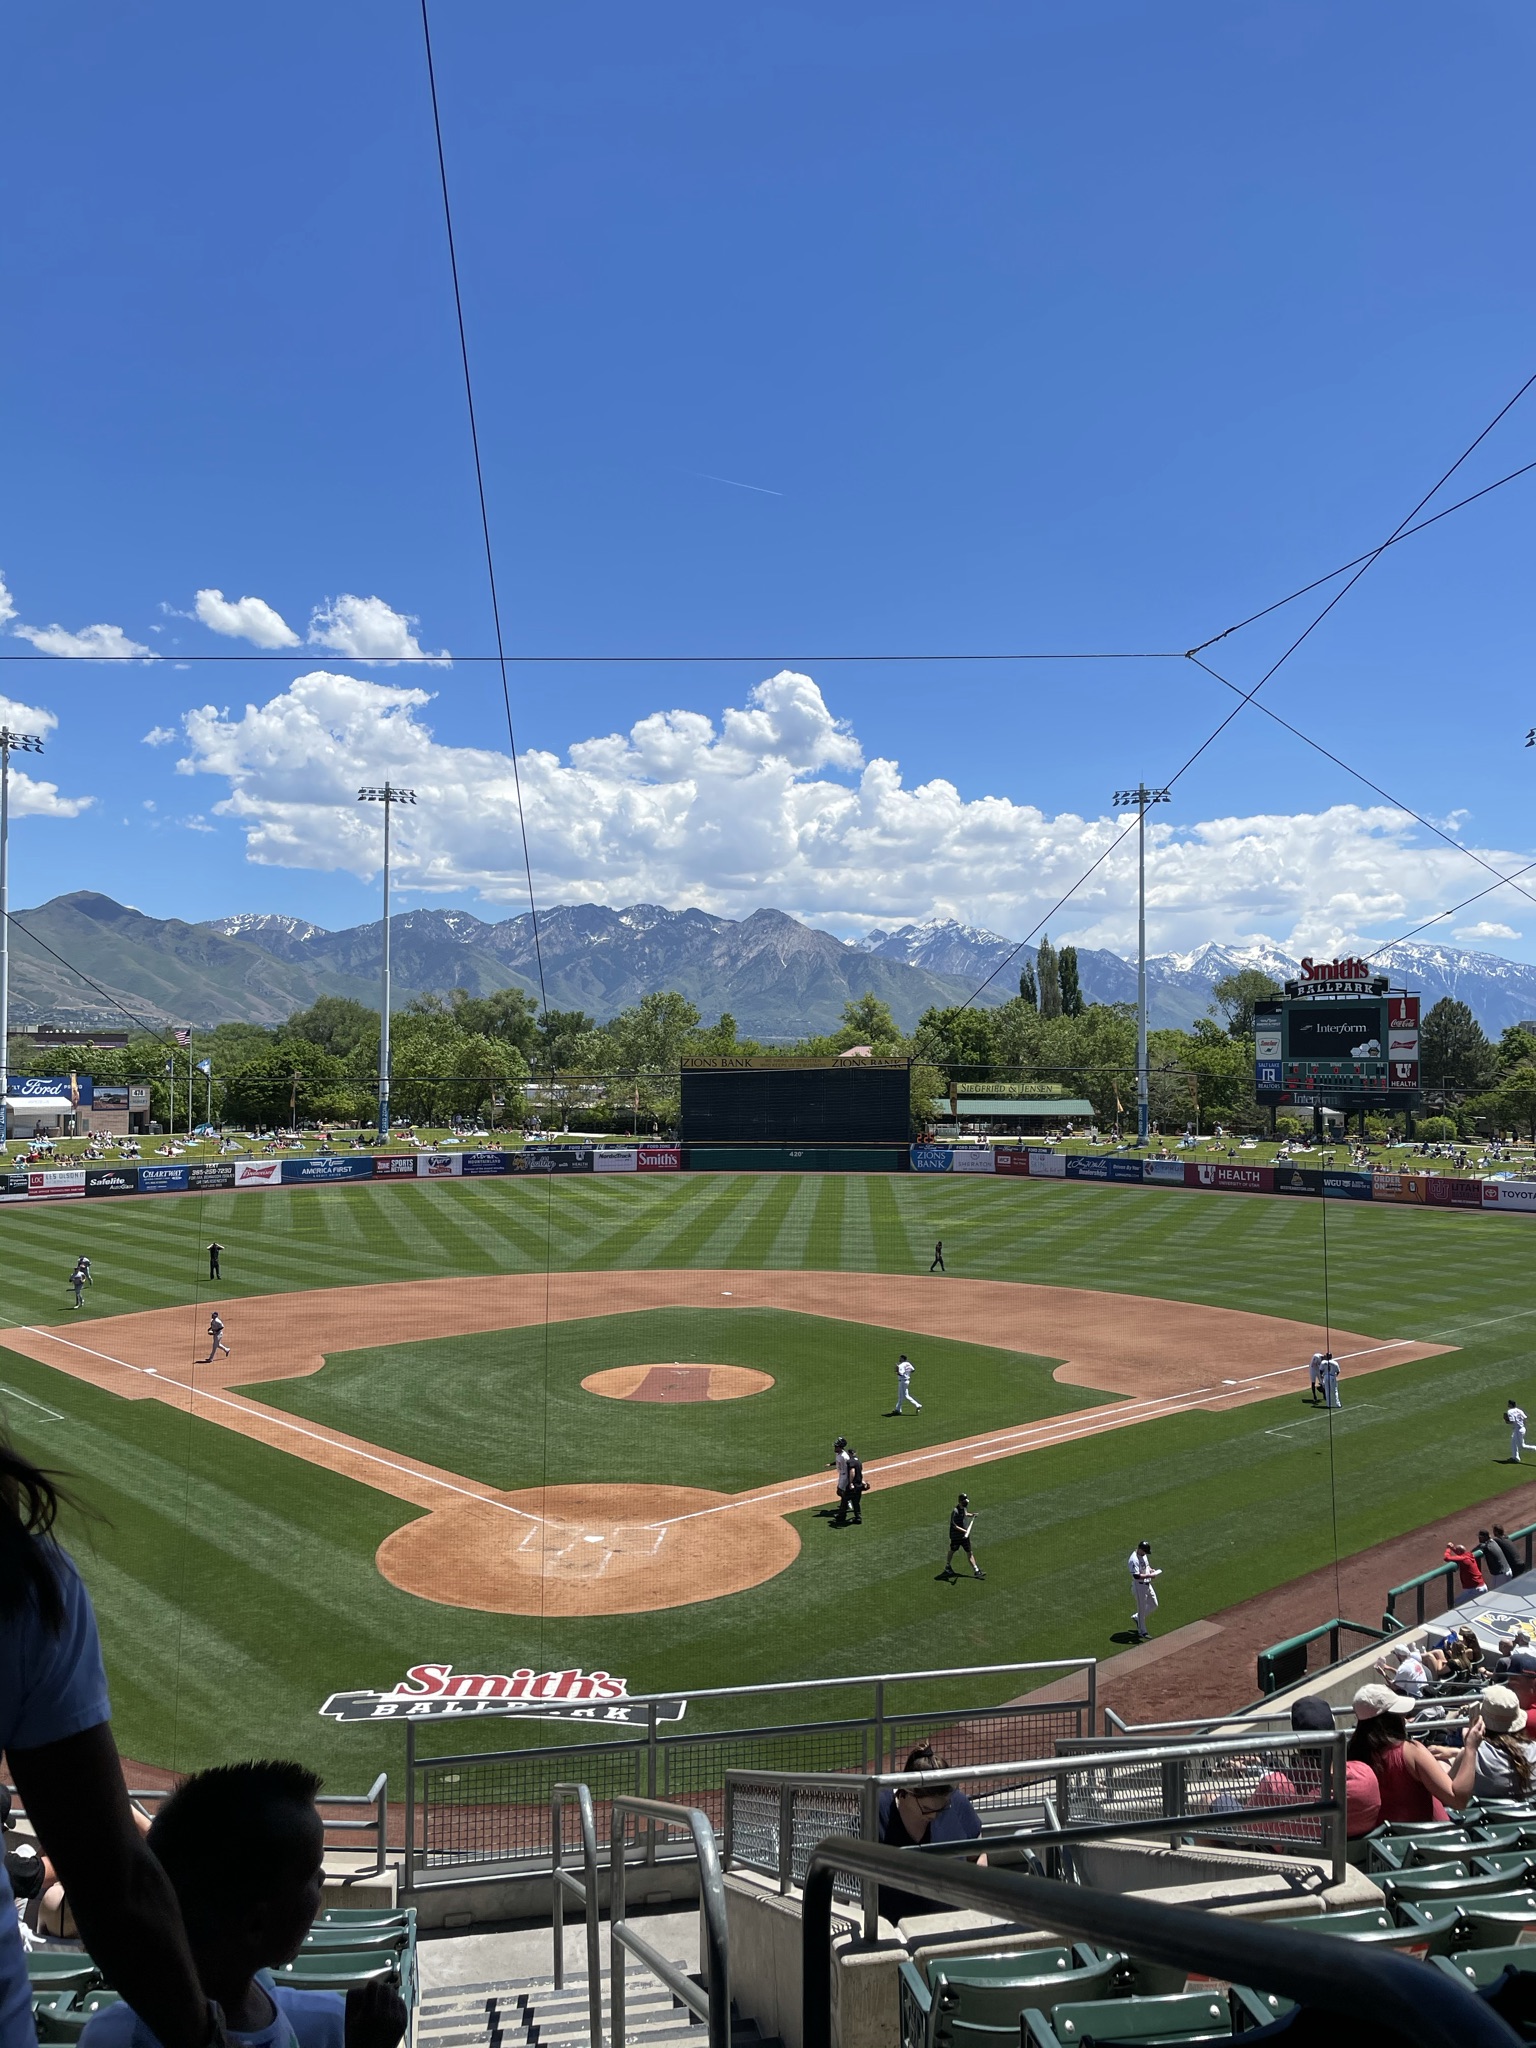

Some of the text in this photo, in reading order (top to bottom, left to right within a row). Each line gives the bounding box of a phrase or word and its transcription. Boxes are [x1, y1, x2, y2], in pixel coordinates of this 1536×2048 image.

[1301, 957, 1369, 981] Smith's
[1298, 982, 1373, 996] BALLPARK
[1316, 1023, 1367, 1034] Interform
[683, 1058, 752, 1068] ZIONS BANK
[832, 1059, 867, 1067] ZIONS
[22, 1079, 62, 1095] Ford
[961, 1083, 1053, 1093] SIEGFRIED & JENSEN
[391, 1159, 414, 1167] SPORTS
[430, 1155, 450, 1167] Farr
[639, 1152, 678, 1166] Smith's
[917, 1160, 945, 1168] BANK
[142, 1170, 184, 1178] CHARTWAY
[244, 1167, 273, 1176] Budweiser
[1218, 1169, 1260, 1181] HEALTH
[90, 1177, 125, 1186] Safelite
[1452, 1183, 1480, 1191] UTAH
[1502, 1190, 1536, 1199] TOYOTA
[398, 1665, 624, 1698] Smith's
